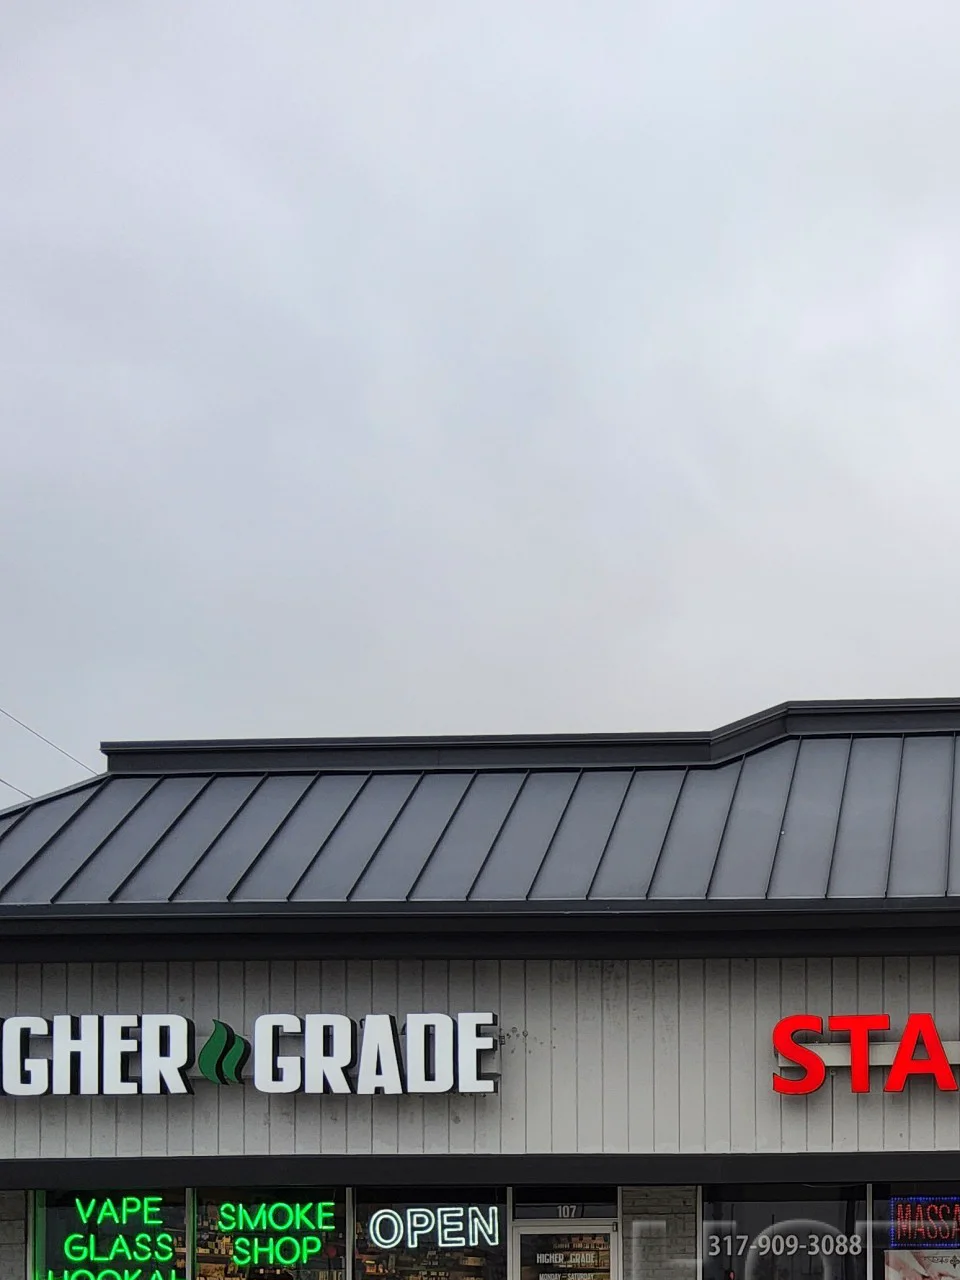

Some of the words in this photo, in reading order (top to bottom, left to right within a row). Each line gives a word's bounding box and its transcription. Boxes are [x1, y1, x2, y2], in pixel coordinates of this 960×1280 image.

[2, 1014, 190, 1095] GHER
[254, 1012, 497, 1095] GRADE
[75, 1196, 164, 1225] VAPE
[217, 1201, 336, 1232] SMOKE
[557, 1205, 577, 1218] 107
[368, 1206, 500, 1249] OPEN
[64, 1233, 174, 1262] GLASS
[232, 1235, 323, 1266] SHOP
[536, 1253, 564, 1264] HIGHER
[570, 1253, 595, 1264] GRADE
[707, 1234, 863, 1257] 317-909-3088
[539, 1273, 561, 1280] MONDAY
[567, 1273, 594, 1280] SATURDAY
